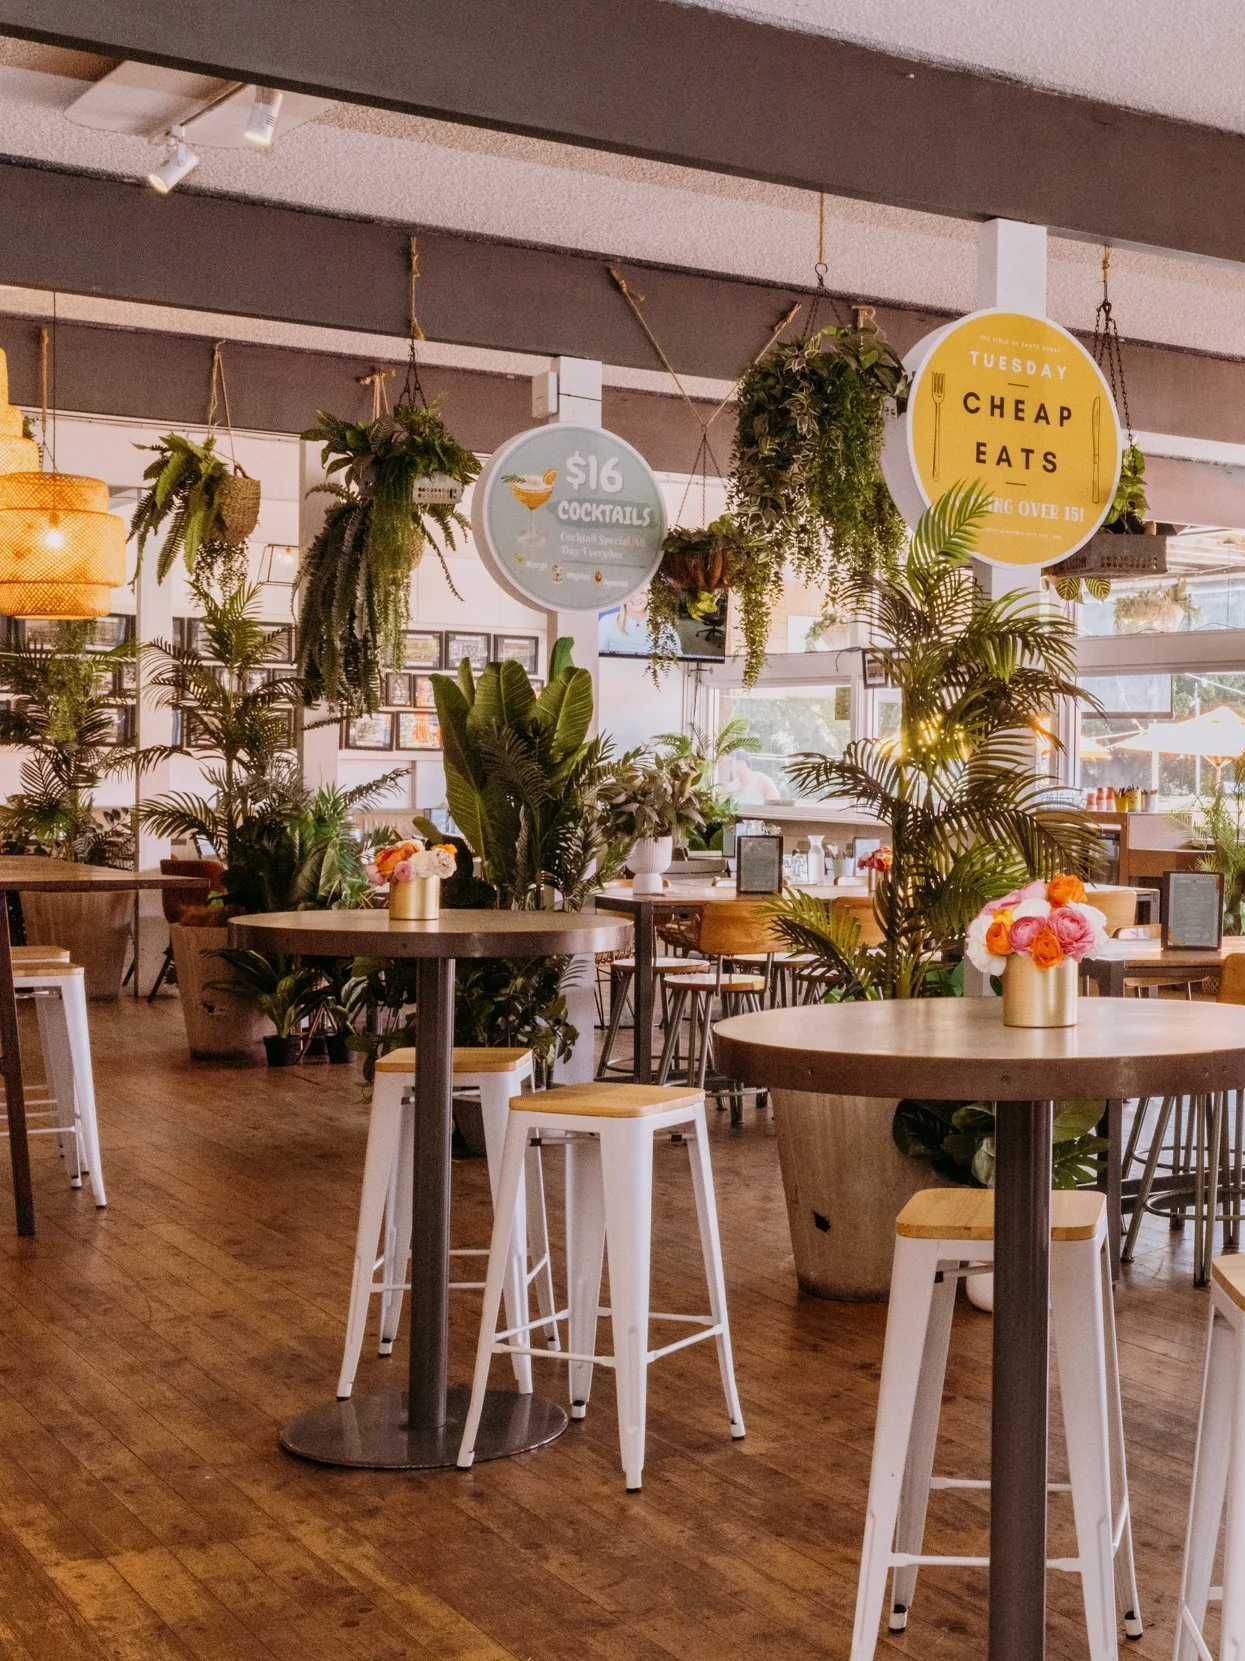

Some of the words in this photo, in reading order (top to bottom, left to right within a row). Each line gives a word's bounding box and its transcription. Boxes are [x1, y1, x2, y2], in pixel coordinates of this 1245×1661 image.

[969, 350, 1067, 380] TUESDAY
[963, 392, 1072, 427] CHEAP
[976, 442, 1057, 473] EATS
[566, 451, 623, 493] $16
[558, 500, 651, 527] COCKTAILS
[1018, 500, 1059, 519] OVER
[1064, 506, 1085, 522] 15!
[560, 531, 597, 544] Cocktail
[598, 534, 631, 547] Special
[560, 544, 579, 557] Day
